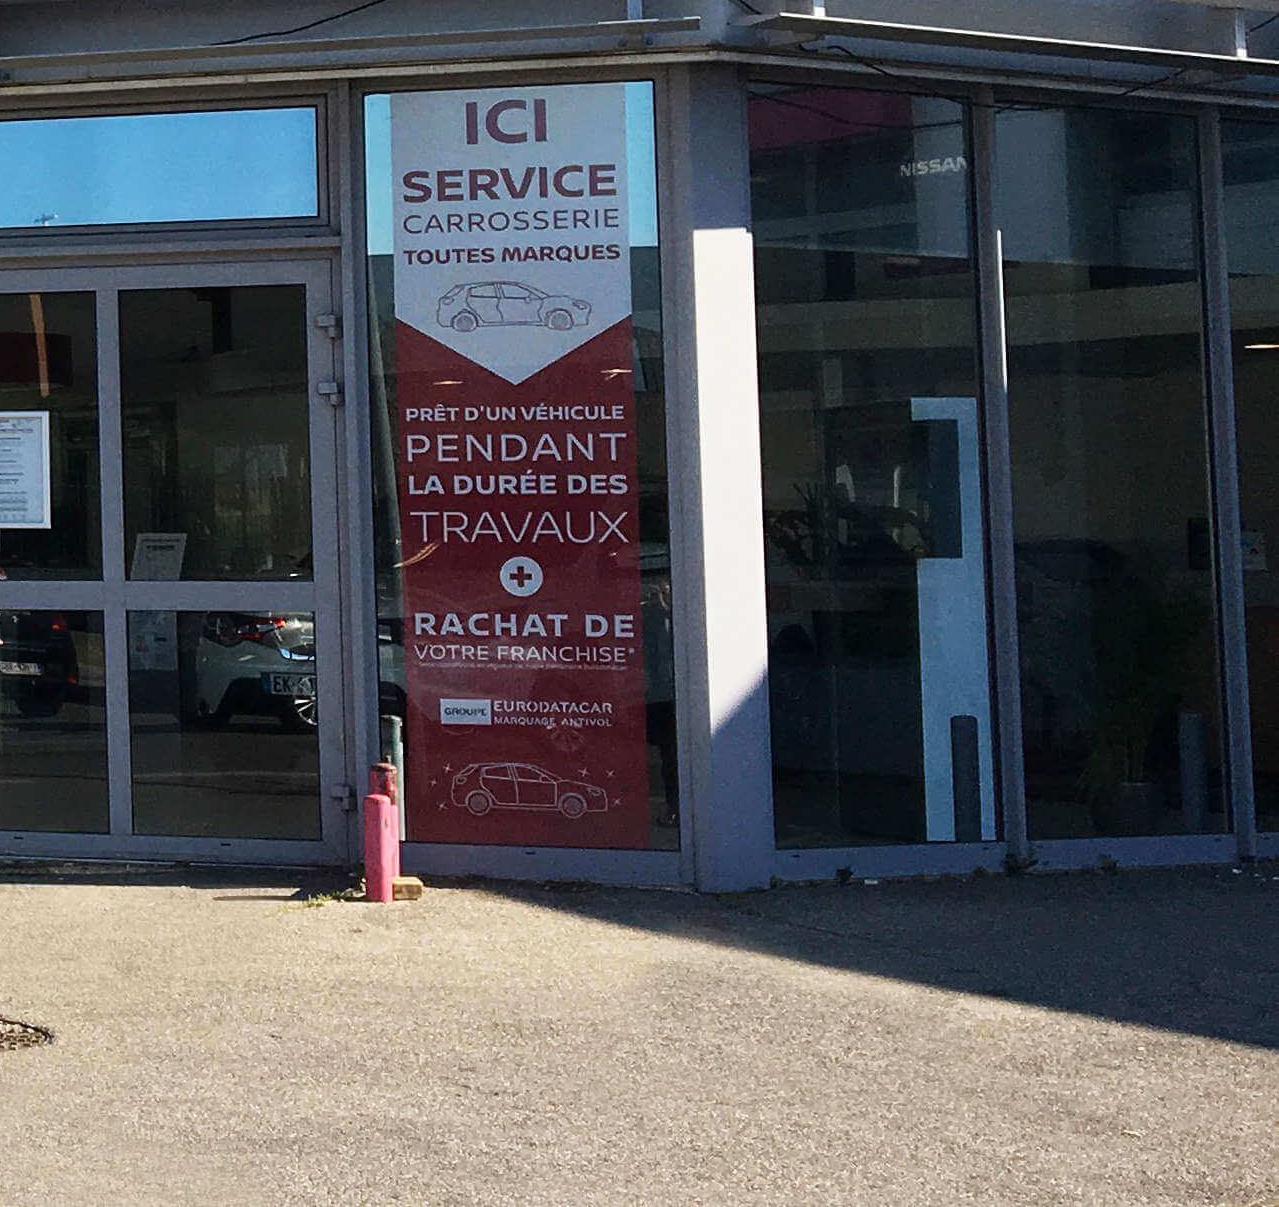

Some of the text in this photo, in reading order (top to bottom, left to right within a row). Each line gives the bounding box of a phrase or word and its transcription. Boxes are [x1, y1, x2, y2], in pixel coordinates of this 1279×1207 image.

[465, 99, 548, 145] ICI
[899, 156, 967, 177] NISSAN
[402, 163, 617, 203] SERVICE
[403, 208, 620, 234] CARROSSERIE
[403, 244, 621, 265] TOUTES MARQUES
[405, 402, 625, 422] PRÊT D'UN VÉHICULE
[406, 432, 628, 462] PENDANT
[408, 469, 629, 495] LA DURÉE DES
[409, 511, 630, 543] TRAVAUX
[414, 612, 635, 638] RACHAT DE
[414, 644, 489, 661] VOTRE
[444, 699, 613, 717] GROUPE EURODATACAR
[561, 716, 613, 728] ANTIVOL
